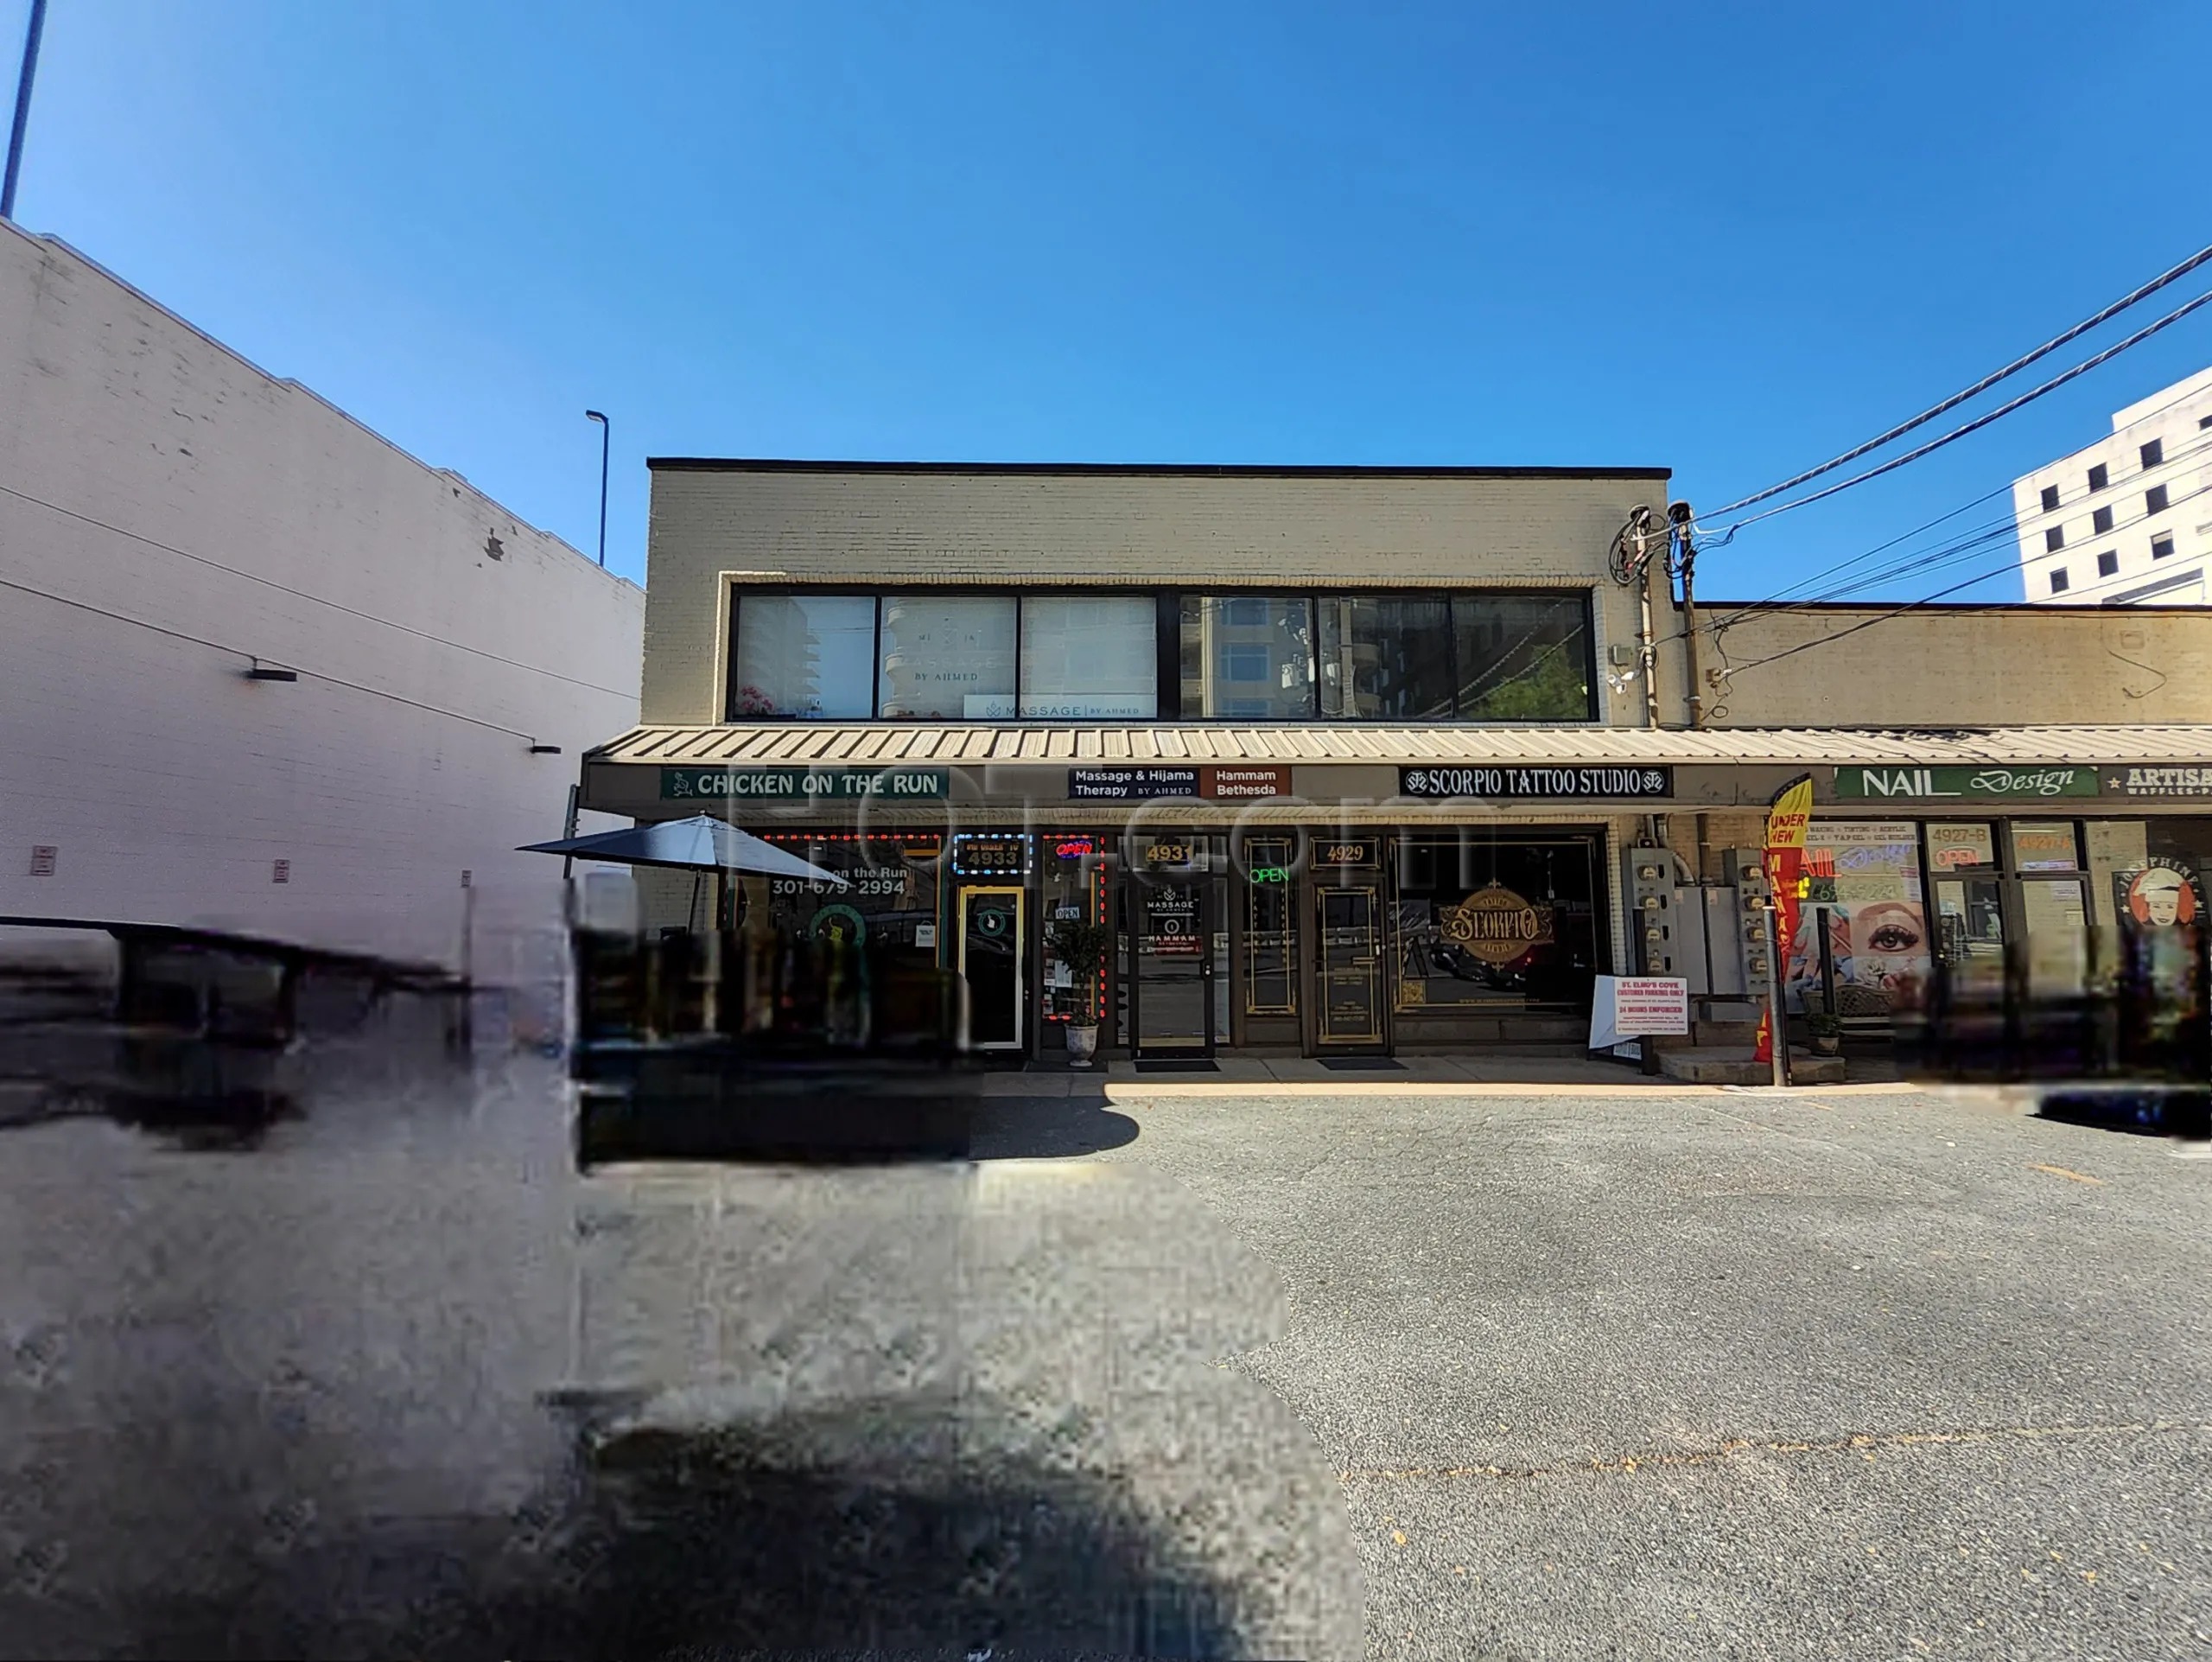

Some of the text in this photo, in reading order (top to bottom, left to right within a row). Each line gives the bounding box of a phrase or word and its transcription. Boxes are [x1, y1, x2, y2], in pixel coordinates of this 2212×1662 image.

[935, 672, 978, 681] AHMED
[1006, 706, 1081, 716] MASSAGE
[1076, 770, 1194, 783] Massage & Hijama
[1217, 770, 1276, 780] Hammam
[1429, 768, 1640, 794] SCORPIO TATTOO STUDIO
[697, 774, 938, 795] CHICKEN ON THE RUN
[1862, 768, 2075, 797] NAIL Design
[1076, 785, 1128, 797] Therapy
[1154, 786, 1192, 795] AHMED
[1217, 785, 1276, 796] Bethesda
[1770, 813, 1806, 830] UNDER
[1770, 831, 1796, 844] NEW
[1933, 828, 1986, 843] 4927-B
[1056, 843, 1093, 856] OPEN
[1147, 844, 1192, 861] 4931
[1327, 845, 1363, 862] 4929
[968, 851, 1017, 865] 4933
[1936, 850, 1979, 866] OPEN
[854, 867, 876, 878] the
[880, 867, 908, 878] Run
[1249, 868, 1290, 883] OPEN
[1057, 908, 1078, 919] OPEN
[1451, 907, 1541, 940] SCORPIO
